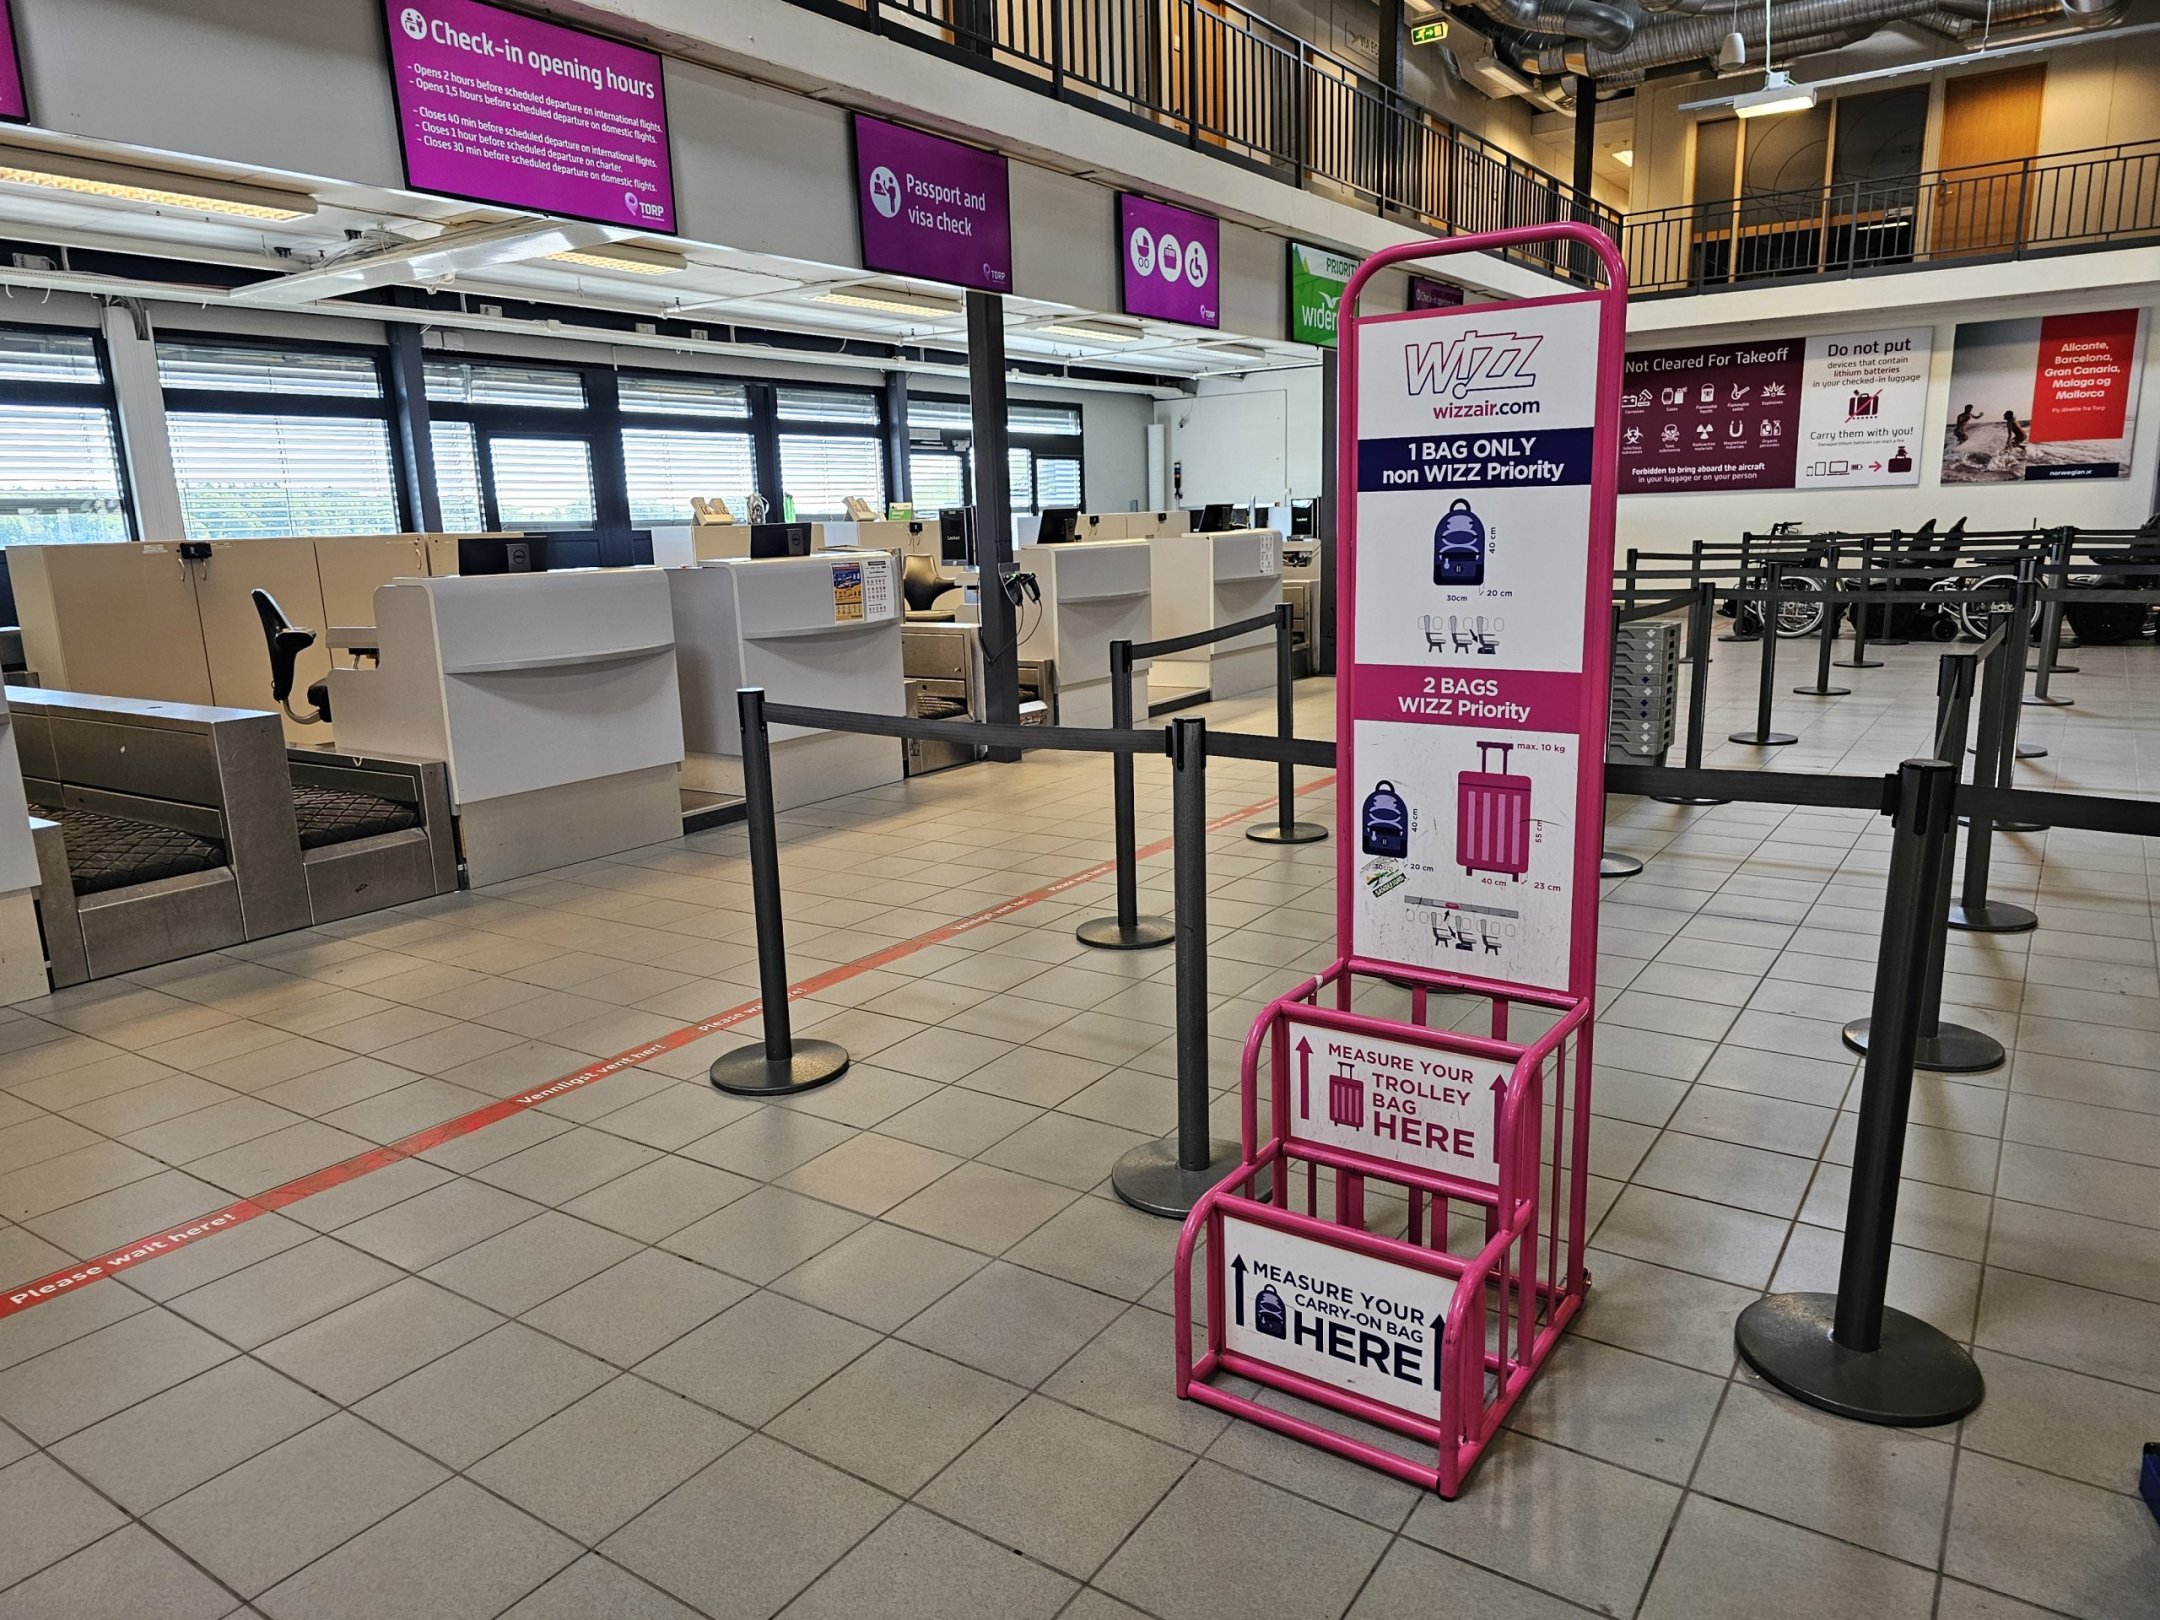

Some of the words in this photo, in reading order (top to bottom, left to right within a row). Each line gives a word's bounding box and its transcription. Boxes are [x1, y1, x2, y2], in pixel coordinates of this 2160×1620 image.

[431, 19, 523, 64] Check-in
[528, 50, 602, 90] opening
[607, 67, 655, 99] hours
[414, 64, 442, 79] Opens
[444, 70, 449, 80] 2
[451, 72, 475, 87] hours
[476, 79, 503, 93] before
[505, 87, 544, 103] scheduled
[546, 96, 582, 113] departure
[594, 108, 639, 126] international
[640, 119, 662, 132] flights.
[416, 78, 444, 93] Opens
[445, 85, 458, 97] 1,5
[459, 88, 483, 102] hours
[484, 94, 511, 109] before
[513, 102, 551, 119] scheduled
[553, 112, 589, 128] departure
[601, 123, 633, 139] domestic
[634, 130, 657, 143] flights.
[420, 106, 446, 121] Closes
[448, 113, 459, 124] 40
[461, 117, 476, 128] min
[478, 119, 503, 134] before
[505, 126, 543, 143] scheduled
[545, 136, 580, 151] departure
[592, 145, 634, 163] international
[635, 155, 657, 168] flights.
[422, 121, 449, 136] Closes
[452, 128, 457, 137] 1
[458, 129, 477, 141] hour
[479, 134, 504, 148] before
[507, 141, 546, 156] scheduled
[548, 149, 584, 165] departure
[596, 158, 623, 173] charter.
[424, 136, 452, 150] Closes
[454, 142, 464, 152] 30
[466, 145, 482, 156] min
[483, 148, 510, 162] before
[511, 155, 550, 171] scheduled
[552, 163, 588, 178] departure
[590, 172, 600, 180] on
[601, 172, 633, 187] domestic
[634, 179, 657, 192] flights.
[906, 173, 961, 206] Passport
[964, 193, 986, 212] and
[640, 202, 664, 217] TORP
[908, 205, 933, 227] visa
[936, 213, 972, 236] check
[992, 270, 1005, 280] TORP
[1302, 302, 1337, 331] wider
[1828, 344, 1848, 357] Do
[1854, 341, 1879, 354] not
[1884, 339, 1911, 355] put
[2061, 342, 2109, 353] Alicante,
[1626, 358, 1648, 373] Not
[1654, 355, 1703, 371] Cleared
[1708, 354, 1730, 367] For
[1736, 348, 1788, 365] Takeoff
[1828, 361, 1857, 369] devices
[1878, 357, 1908, 365] contain
[2055, 354, 2112, 365] Barcelona,
[1834, 369, 1861, 377] lithium
[1864, 366, 1900, 375] batteries
[1842, 376, 1886, 385] checked-in
[1888, 375, 1921, 383] luggage
[2045, 368, 2071, 377] Gran
[2073, 365, 2120, 375] Canaria,
[2052, 378, 2095, 388] Malaga
[2097, 378, 2111, 386] og
[2056, 389, 2105, 400] Mallorca
[1433, 400, 1540, 420] wizzair.com
[1811, 431, 1835, 440] Carry
[1839, 430, 1863, 438] them
[1867, 428, 1889, 437] with
[1892, 427, 1913, 437] you!
[1408, 443, 1416, 460] 1
[1422, 440, 1467, 460] BAG
[1473, 437, 1536, 456] ONLY
[1383, 468, 1418, 484] non
[1424, 464, 1481, 483] WIZZ
[1488, 460, 1564, 482] Priority
[1647, 476, 1663, 484] your
[1664, 474, 1692, 483] luggage
[1732, 473, 1757, 481] person
[1677, 466, 1696, 475] bring
[1738, 463, 1765, 471] aircraft
[1490, 527, 1496, 538] cm
[1489, 541, 1496, 554] 40
[1424, 677, 1434, 693] 2
[1441, 678, 1499, 696] BAGS
[1399, 697, 1452, 715] WIZZ
[1458, 700, 1530, 722] Priority
[1518, 743, 1538, 751] max.
[1555, 745, 1565, 754] kg
[1412, 808, 1418, 819] cm
[1411, 822, 1418, 832] 40
[1537, 820, 1542, 831] cm
[1536, 834, 1542, 843] 55
[1494, 879, 1506, 887] cm
[698, 1012, 745, 1033] Please
[1329, 1043, 1413, 1072] MEASURE
[1420, 1062, 1473, 1084] YOUR
[516, 1071, 600, 1105] Vennligst
[597, 1057, 635, 1074] vent
[631, 1044, 666, 1060] her!
[1372, 1073, 1471, 1106] TROLLEY
[1373, 1092, 1416, 1115] BAG
[1374, 1112, 1475, 1158] HERE
[10, 1266, 103, 1304] Please
[108, 1240, 168, 1266] wait
[168, 1214, 236, 1242] here!
[1253, 1260, 1352, 1304] MEASURE
[1360, 1293, 1424, 1326] YOUR
[1295, 1294, 1382, 1333] CARRY-ON
[1387, 1322, 1424, 1343] BAG
[1294, 1310, 1423, 1385] HERE
